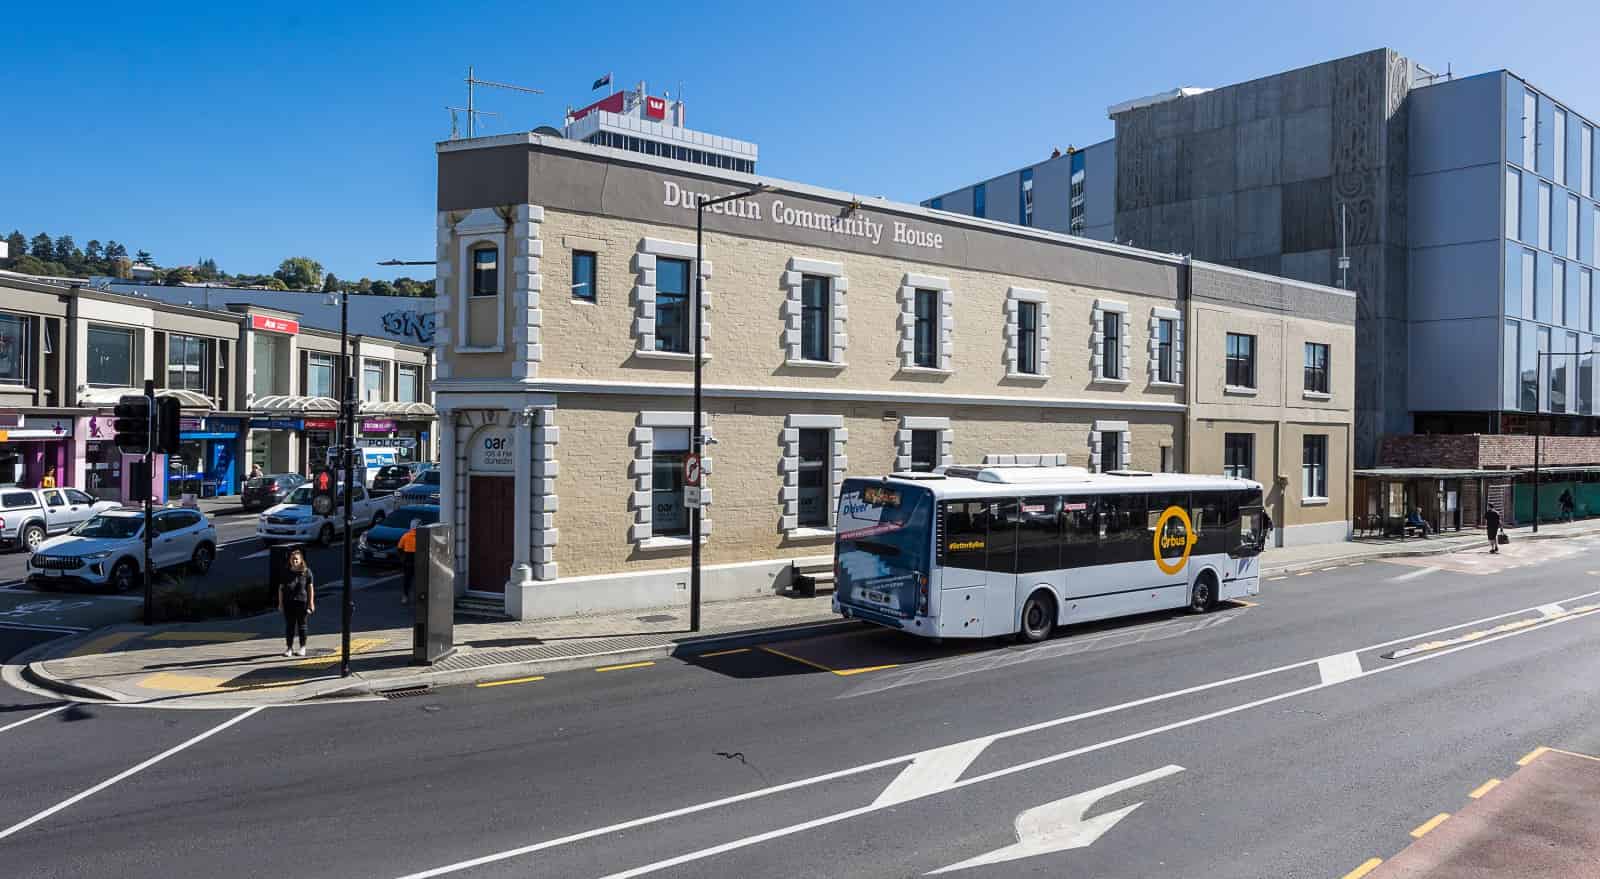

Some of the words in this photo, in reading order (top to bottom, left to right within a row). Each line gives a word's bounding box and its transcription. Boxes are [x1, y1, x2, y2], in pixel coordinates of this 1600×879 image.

[663, 181, 762, 220] Dunedin
[772, 199, 883, 245] Community
[893, 220, 944, 249] House
[368, 439, 407, 448] POLICE
[484, 438, 506, 449] oar
